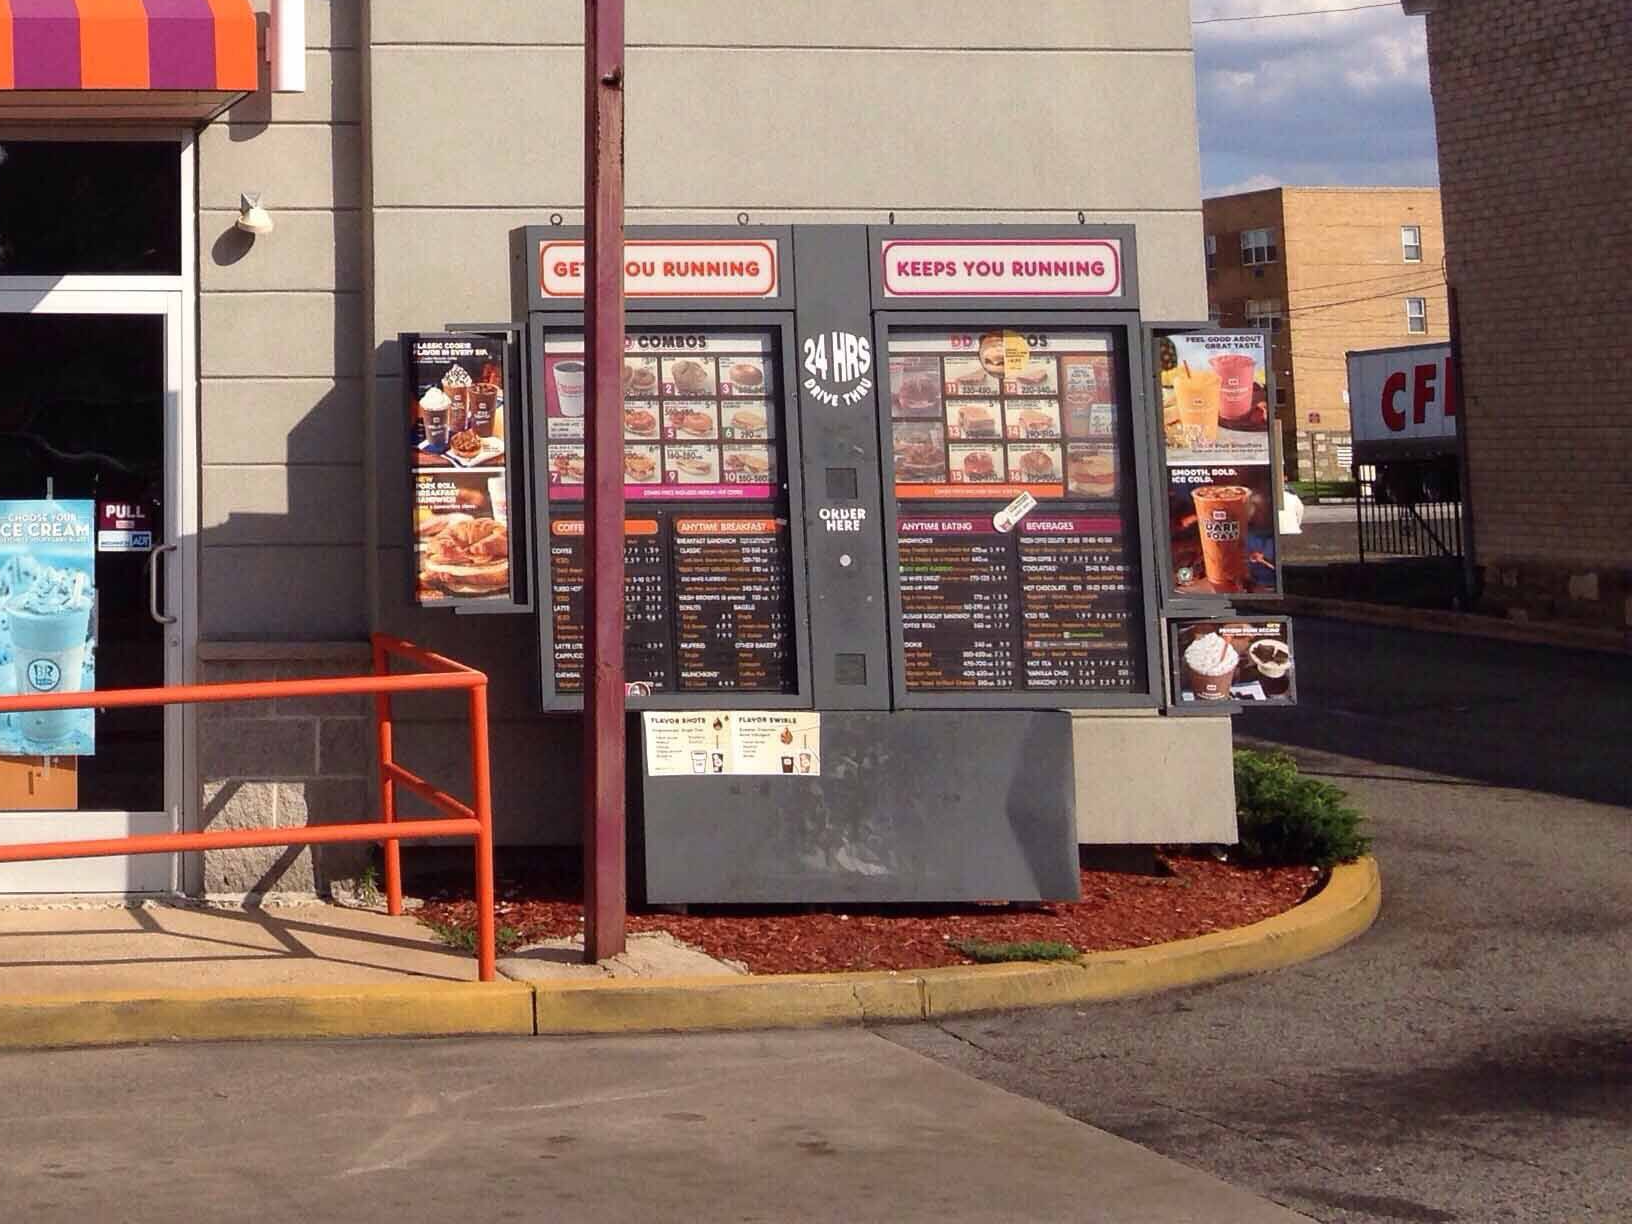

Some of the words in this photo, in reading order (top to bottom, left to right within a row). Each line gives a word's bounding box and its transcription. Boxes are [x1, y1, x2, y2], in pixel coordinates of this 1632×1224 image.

[625, 261, 655, 277] OU
[663, 261, 760, 277] RUNNING
[897, 261, 957, 277] KEEPS
[963, 261, 1005, 277] YOU
[1012, 260, 1105, 277] RUNNING
[638, 335, 707, 348] COMBOS
[804, 333, 827, 380] 24
[832, 331, 871, 382] HRS
[804, 378, 838, 406] DRIVE
[843, 378, 872, 406] THRU
[8, 513, 48, 521] CHOOSE
[106, 505, 144, 518] PULL
[818, 508, 866, 520] ORDER
[29, 523, 89, 536] CREAM
[557, 523, 584, 532] COFFE
[826, 520, 860, 531] HERE
[902, 522, 939, 530] ANYTIME
[942, 522, 972, 530] EATING
[1026, 522, 1074, 530] BEVERAGES
